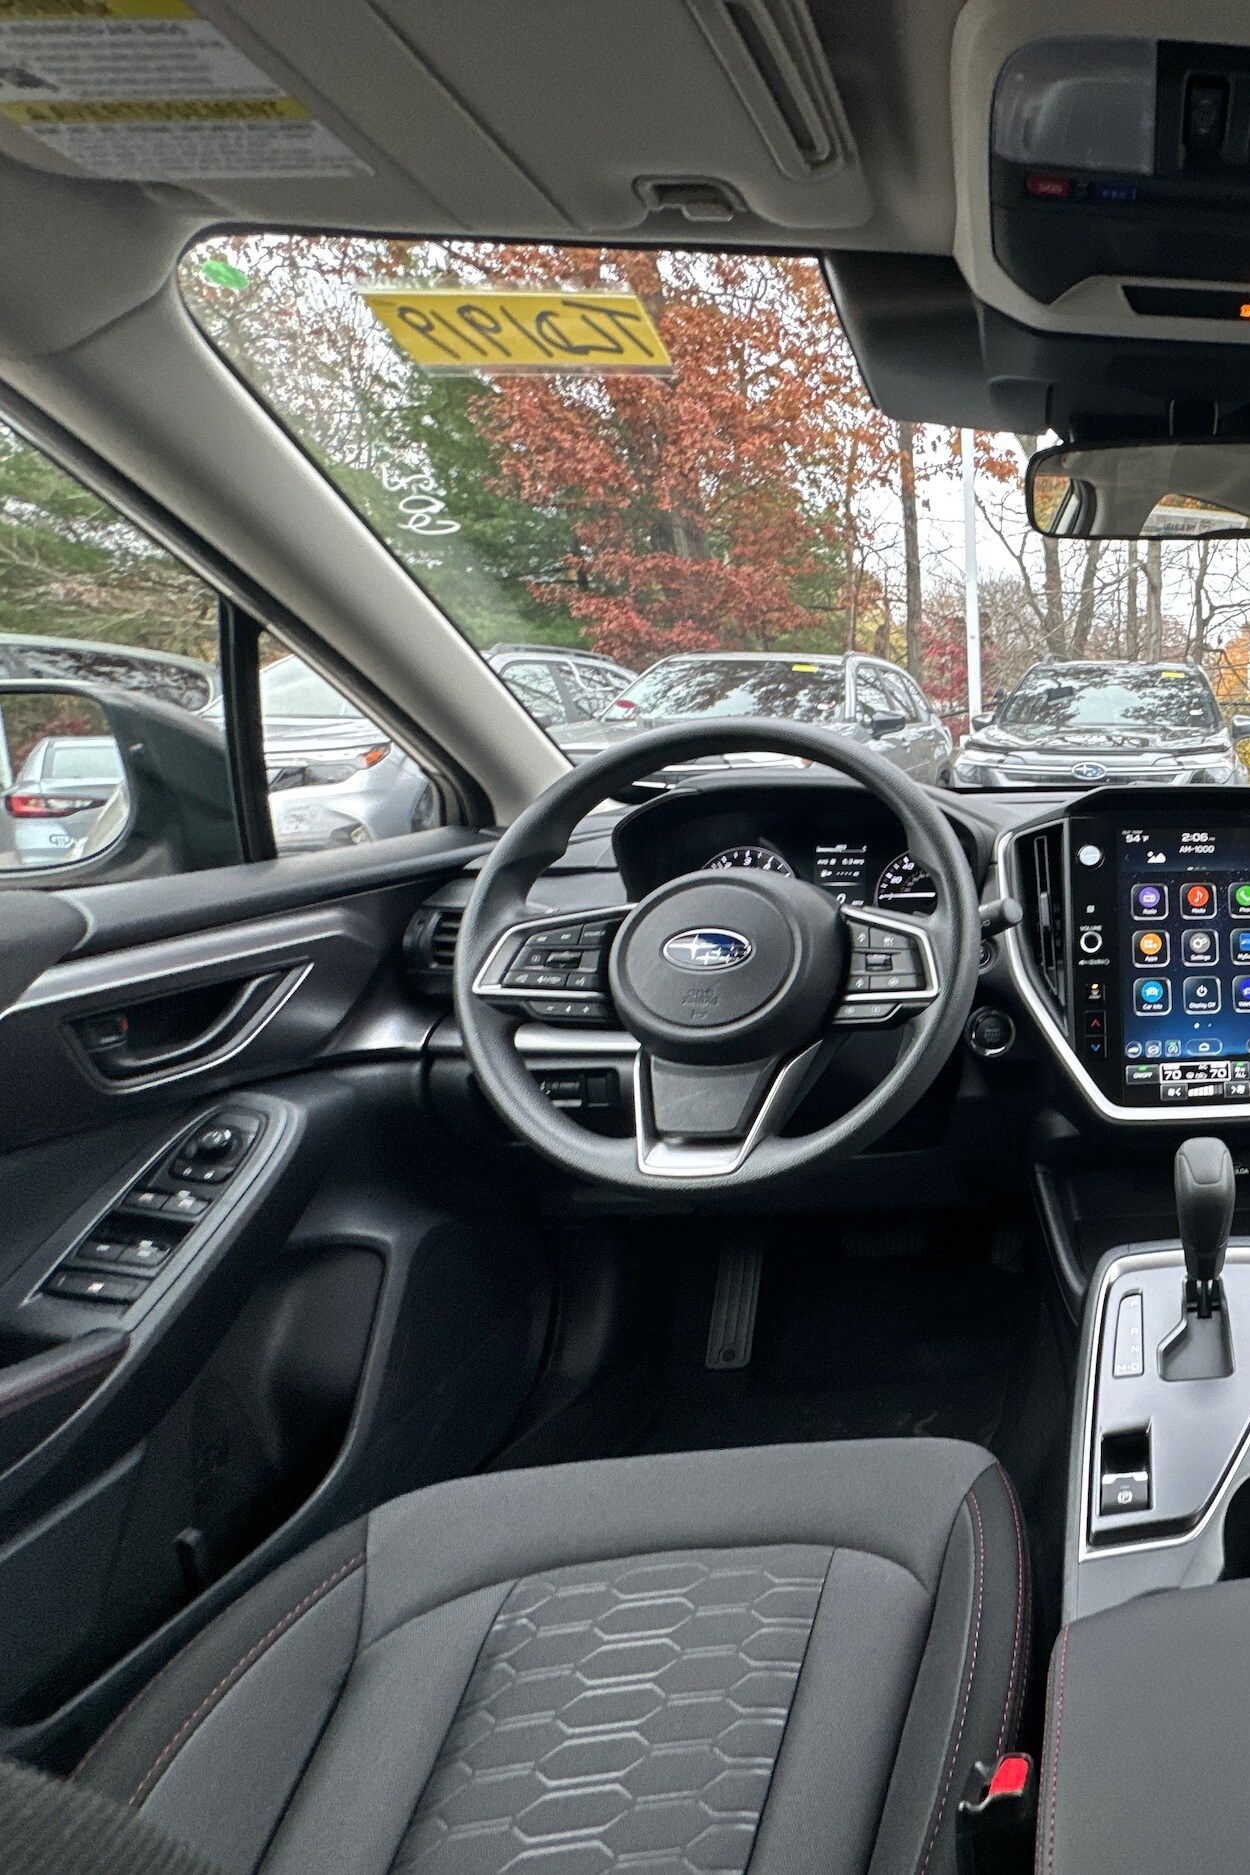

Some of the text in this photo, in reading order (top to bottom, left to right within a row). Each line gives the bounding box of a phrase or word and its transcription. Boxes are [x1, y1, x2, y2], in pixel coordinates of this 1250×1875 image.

[1181, 832, 1208, 842] 2:06
[1163, 1070, 1183, 1081] 70
[1208, 1068, 1228, 1079] 70
[1131, 1344, 1139, 1353] N
